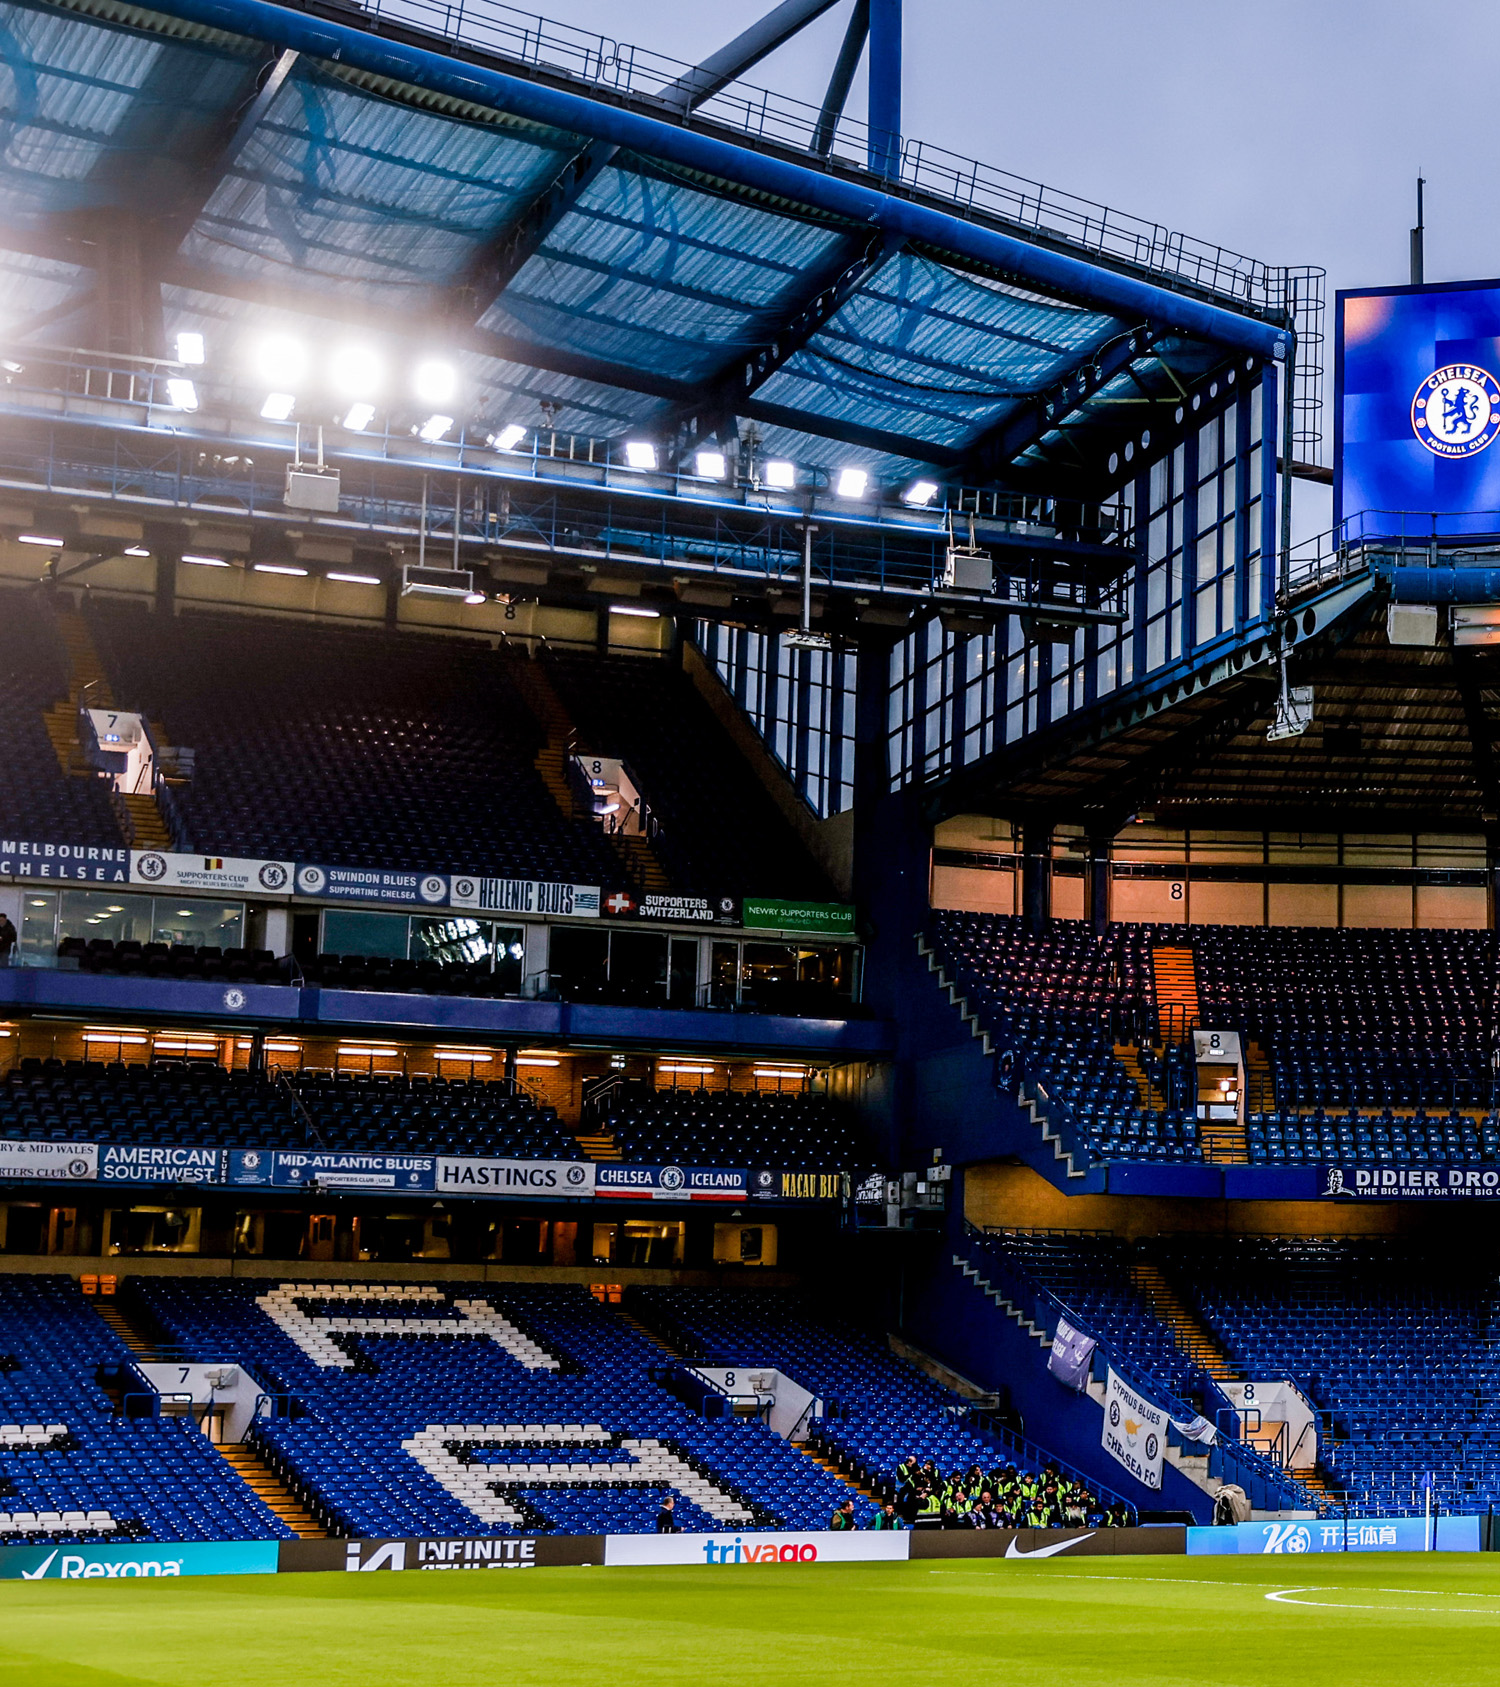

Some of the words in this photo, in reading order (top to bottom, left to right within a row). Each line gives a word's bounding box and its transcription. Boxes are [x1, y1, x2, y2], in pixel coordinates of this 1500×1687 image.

[1428, 367, 1488, 389] CHELSEA
[1427, 437, 1466, 453] FOOTBALL
[1469, 433, 1489, 449] CLUB
[505, 604, 516, 620] 8
[107, 714, 118, 728] 7
[592, 760, 602, 774] 8
[2, 840, 126, 862] MELBOURNE
[0, 861, 125, 882] CHELSEA
[176, 870, 228, 882] SUPPORTERS
[228, 874, 249, 883] CLUB
[329, 870, 380, 884] SWINDON
[383, 874, 417, 887] BLUES
[329, 885, 379, 897] SUPPORTING
[381, 889, 416, 899] CHELSEA
[479, 878, 533, 912] HELLENIC
[537, 883, 574, 914] BLUES
[1171, 882, 1183, 900] 8
[645, 895, 708, 909] SUPPORTERS
[639, 906, 714, 920] SWITZERLAND
[748, 906, 779, 916] NEWRY
[780, 909, 829, 919] SUPPORTERS
[831, 912, 852, 921] CLUB
[1210, 1033, 1221, 1048] 8
[17, 1145, 27, 1153] &
[29, 1144, 53, 1153] MID
[57, 1145, 94, 1155] WALES
[104, 1147, 216, 1166] AMERICAN
[278, 1154, 383, 1169] MID-ATLANTIC
[385, 1157, 432, 1171] BLUES
[36, 1168, 67, 1178] CLUB
[103, 1165, 215, 1182] SOUTHWEST
[443, 1165, 558, 1188] HASTINGS
[600, 1169, 653, 1184] CHELSEA
[690, 1173, 742, 1187] ICELAND
[1356, 1170, 1440, 1187] DIDIER
[1357, 1187, 1378, 1195] THE
[1380, 1187, 1399, 1195] BIG
[1402, 1187, 1425, 1196] MAN
[1428, 1187, 1449, 1196] FOR
[1451, 1187, 1472, 1196] THE
[1475, 1187, 1493, 1196] BIG
[178, 1367, 190, 1384] 7
[724, 1371, 736, 1387] 8
[1244, 1384, 1255, 1400] 8
[1112, 1379, 1138, 1410] CYPRUS
[1138, 1404, 1161, 1425] BLUES
[1106, 1432, 1142, 1478] CHELSEA
[1144, 1469, 1156, 1486] FC
[418, 1540, 536, 1561] INFINITE
[703, 1537, 818, 1564] trivago
[61, 1555, 181, 1579] Rexona
